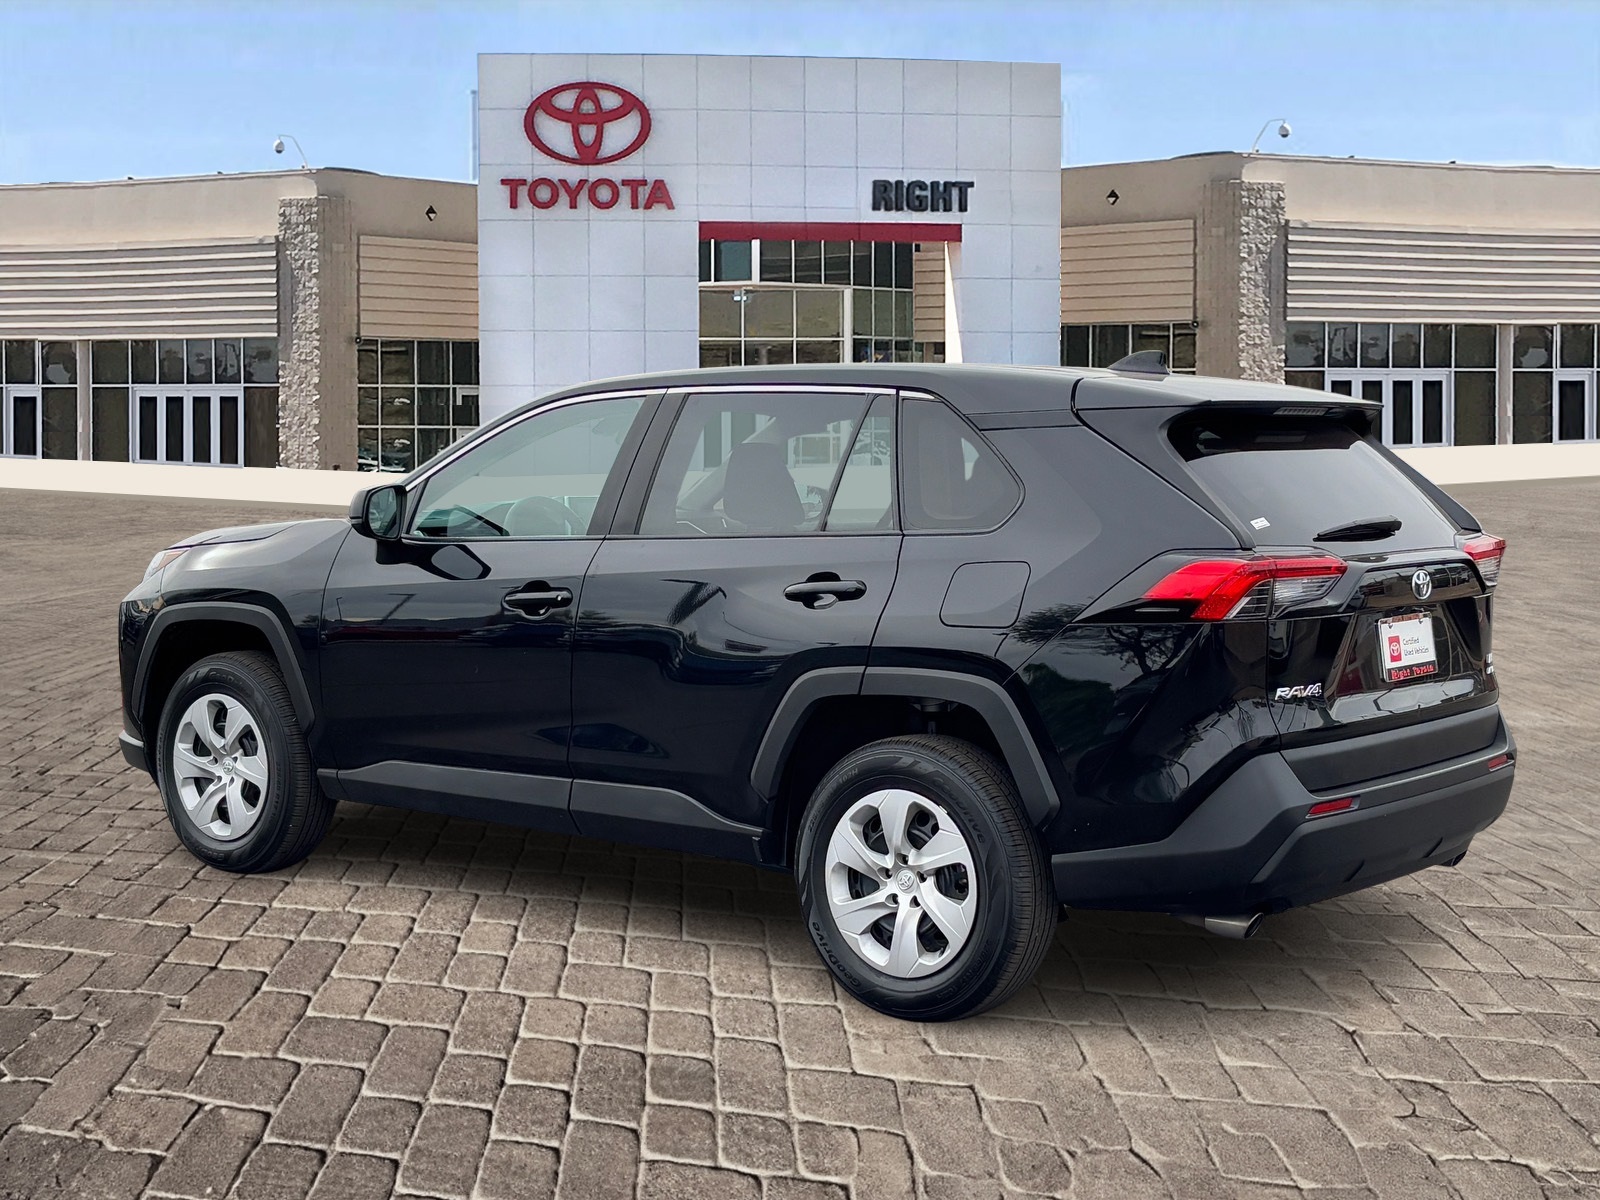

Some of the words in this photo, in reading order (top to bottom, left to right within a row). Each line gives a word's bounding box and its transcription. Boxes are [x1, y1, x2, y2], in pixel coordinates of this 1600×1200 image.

[500, 178, 675, 210] TOYOTA
[870, 180, 975, 213] RIGHT
[1391, 668, 1411, 680] Right
[1412, 664, 1434, 677] Toyota
[1274, 682, 1323, 701] RAV4
[811, 920, 863, 989] GeoDrive
